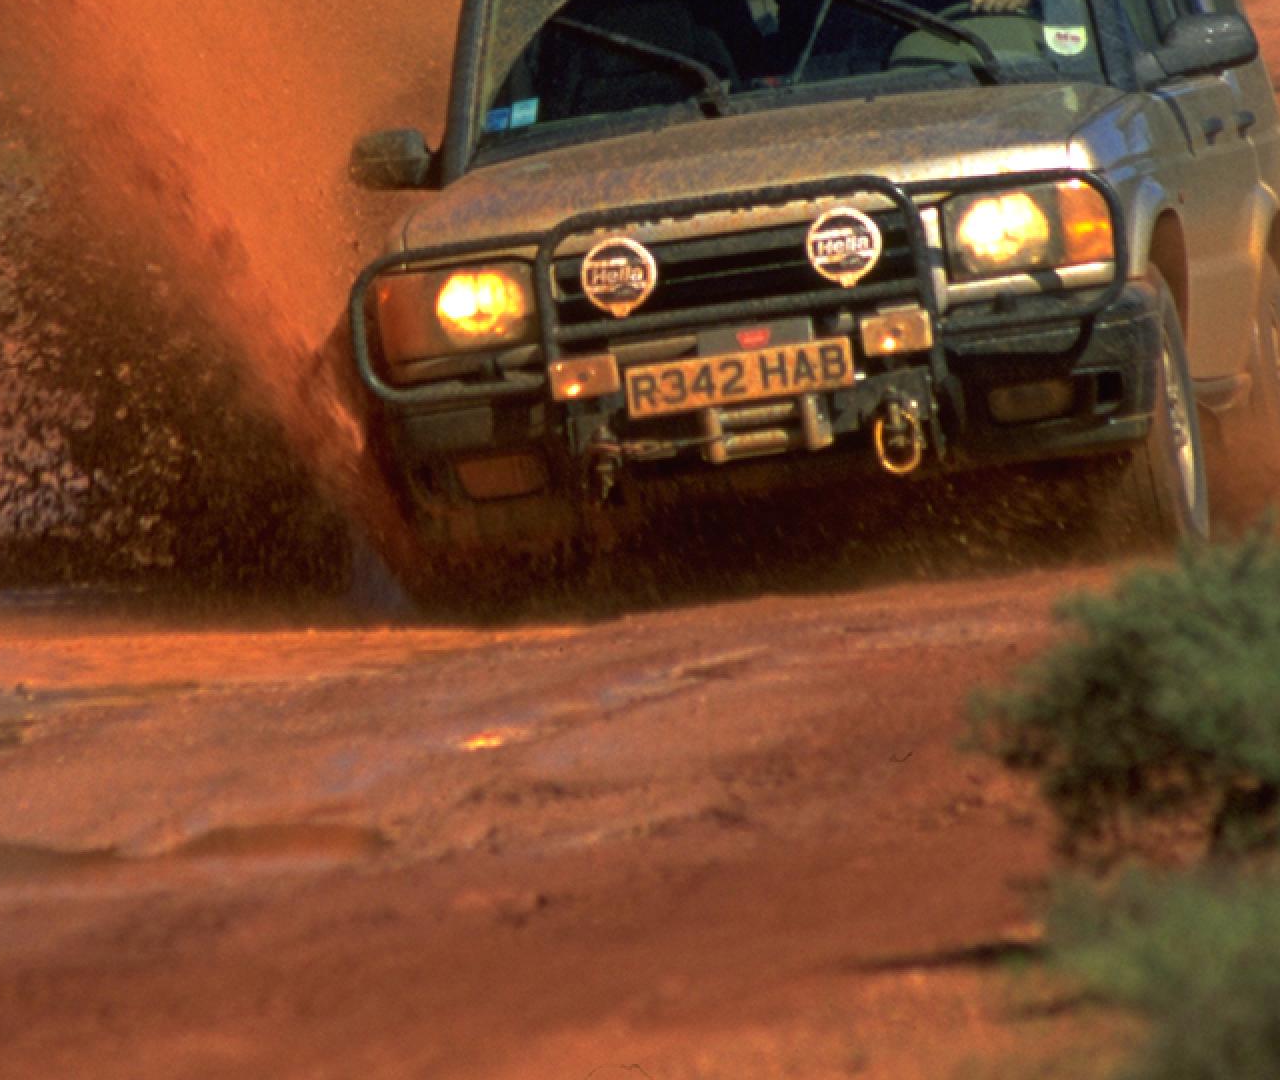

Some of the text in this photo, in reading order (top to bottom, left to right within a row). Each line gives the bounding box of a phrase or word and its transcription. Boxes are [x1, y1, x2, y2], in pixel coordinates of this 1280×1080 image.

[817, 234, 870, 257] Hella
[591, 264, 643, 286] Hella
[631, 345, 847, 409] R342 HAB
